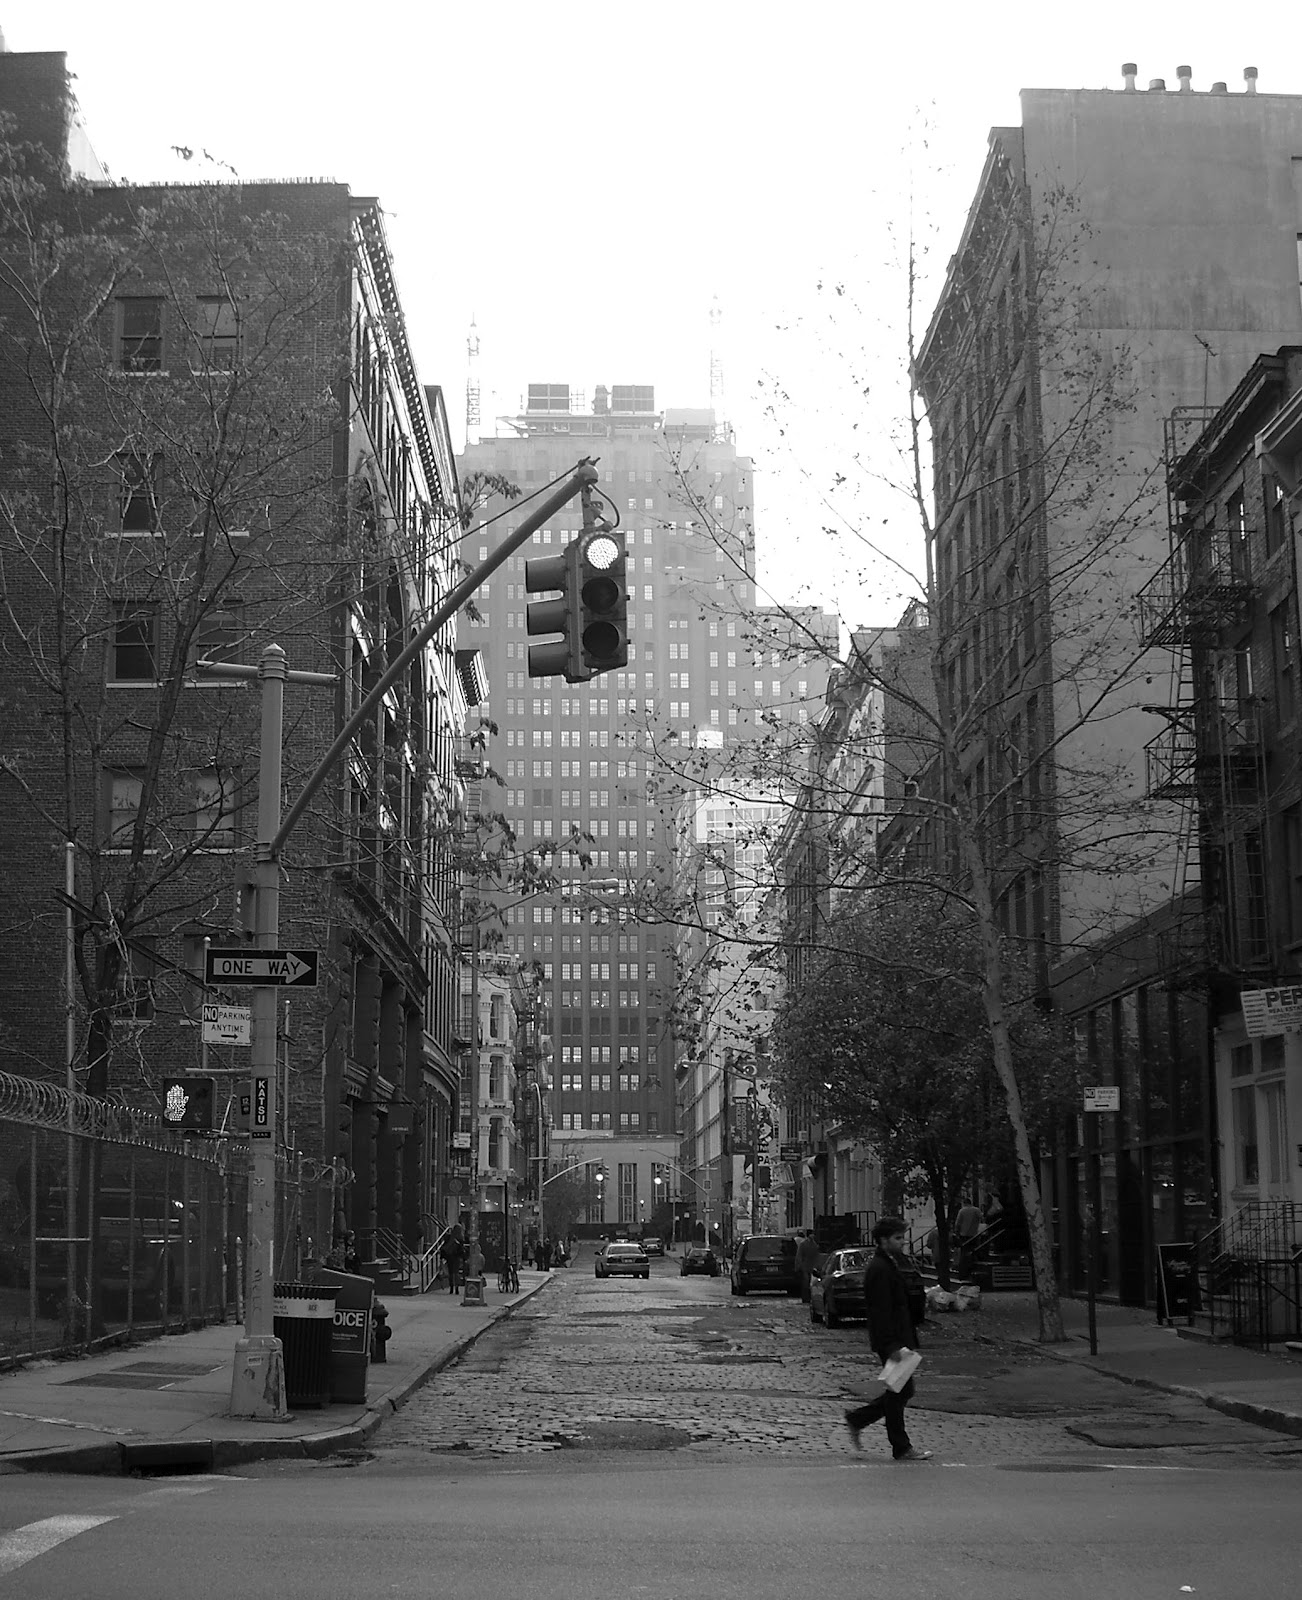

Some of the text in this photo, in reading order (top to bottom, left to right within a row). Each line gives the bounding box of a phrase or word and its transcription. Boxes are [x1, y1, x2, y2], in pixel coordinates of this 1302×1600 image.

[222, 960, 301, 975] ONE WAY
[204, 1007, 251, 1020] NO PARKING
[211, 1024, 244, 1033] ANYTIME
[258, 1080, 266, 1124] KATSU
[333, 1311, 365, 1327] OICE
